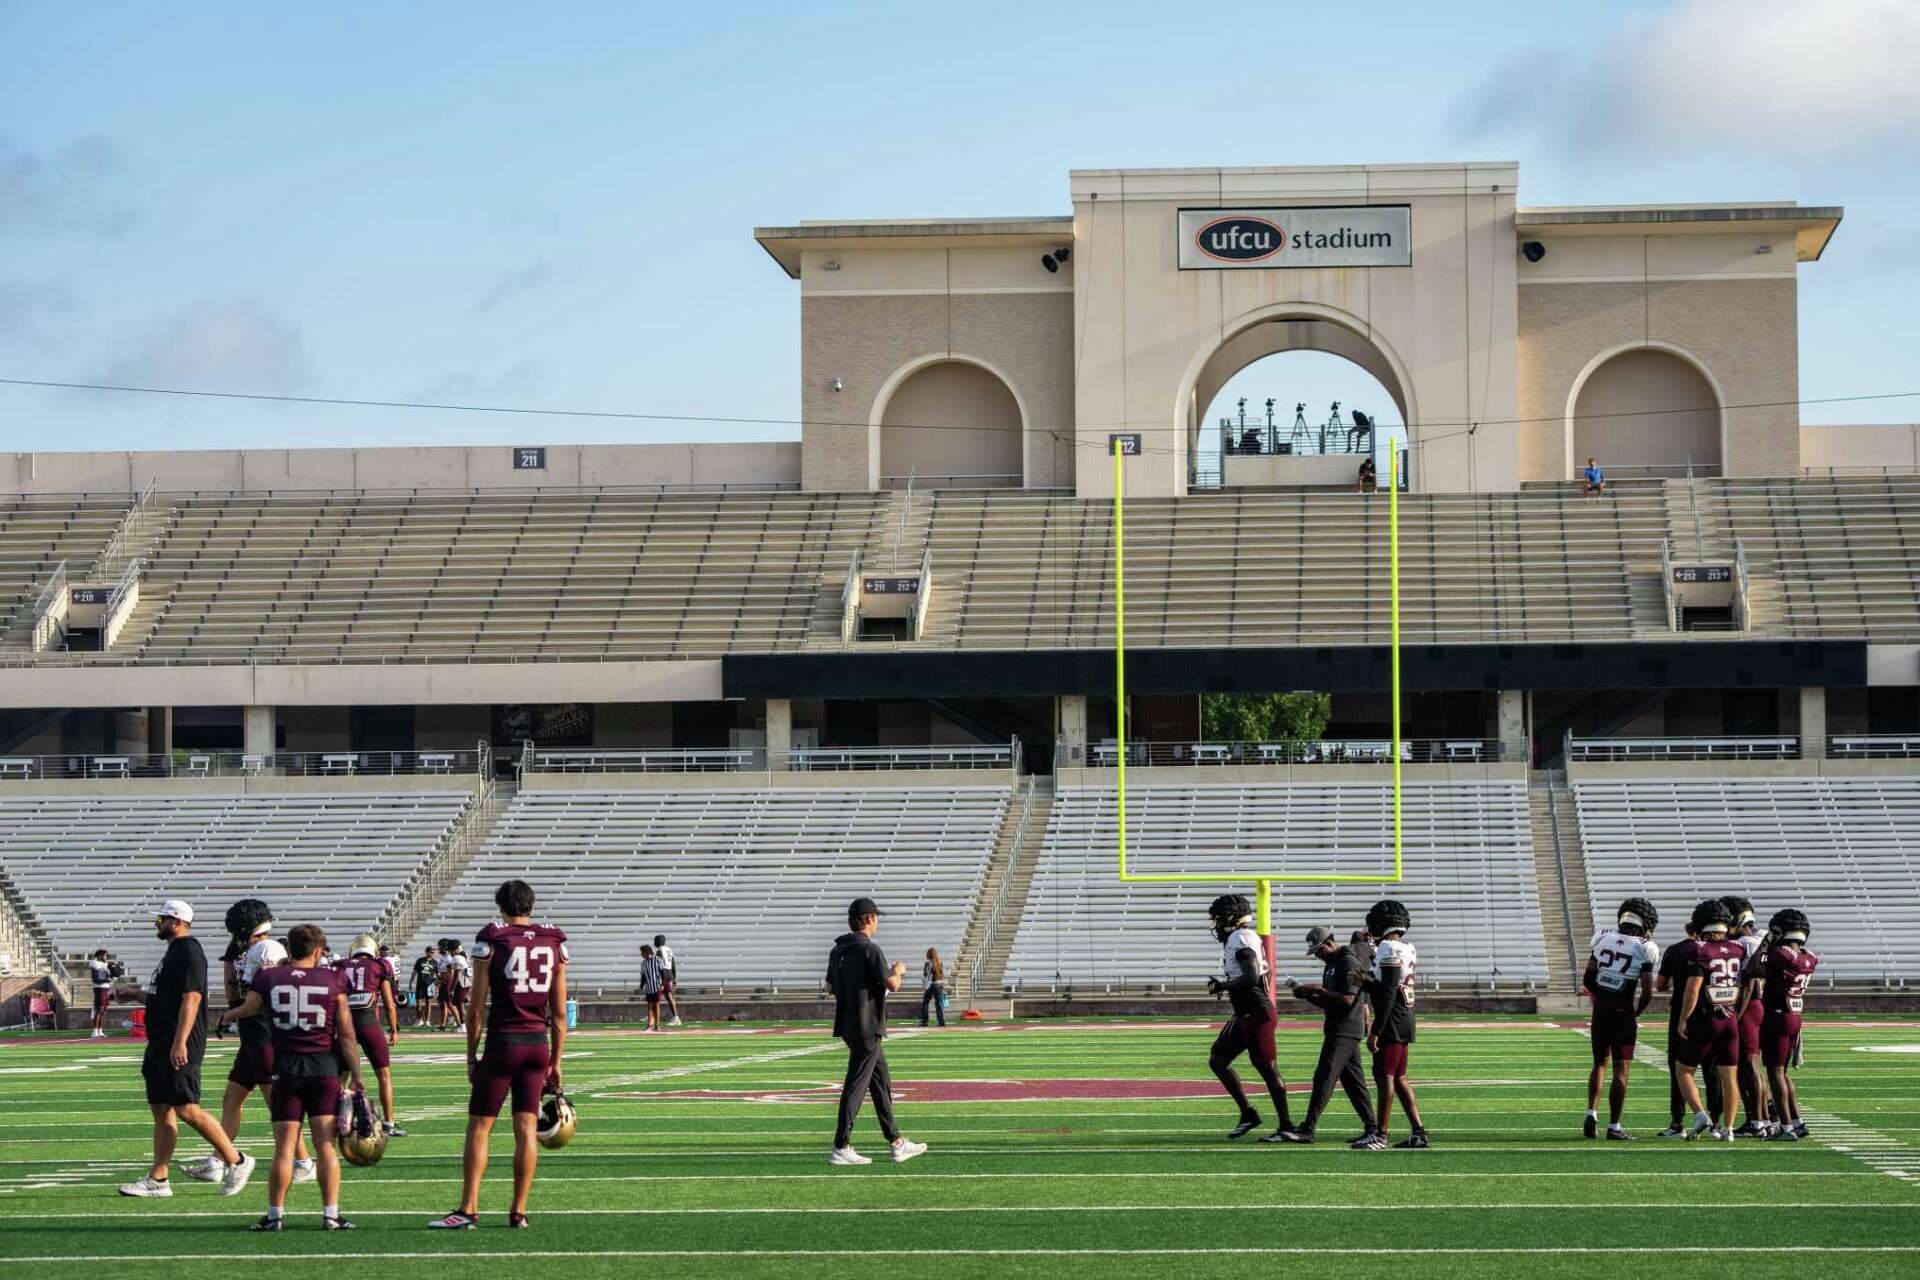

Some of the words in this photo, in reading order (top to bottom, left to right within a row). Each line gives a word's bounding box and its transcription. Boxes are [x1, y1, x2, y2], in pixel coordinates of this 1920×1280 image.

[1211, 226, 1270, 250] ufcu
[1291, 228, 1392, 249] stadium
[521, 454, 537, 467] 211
[504, 946, 554, 993] 43
[1599, 949, 1633, 974] 27
[1709, 957, 1741, 987] 29
[270, 984, 329, 1031] 95
